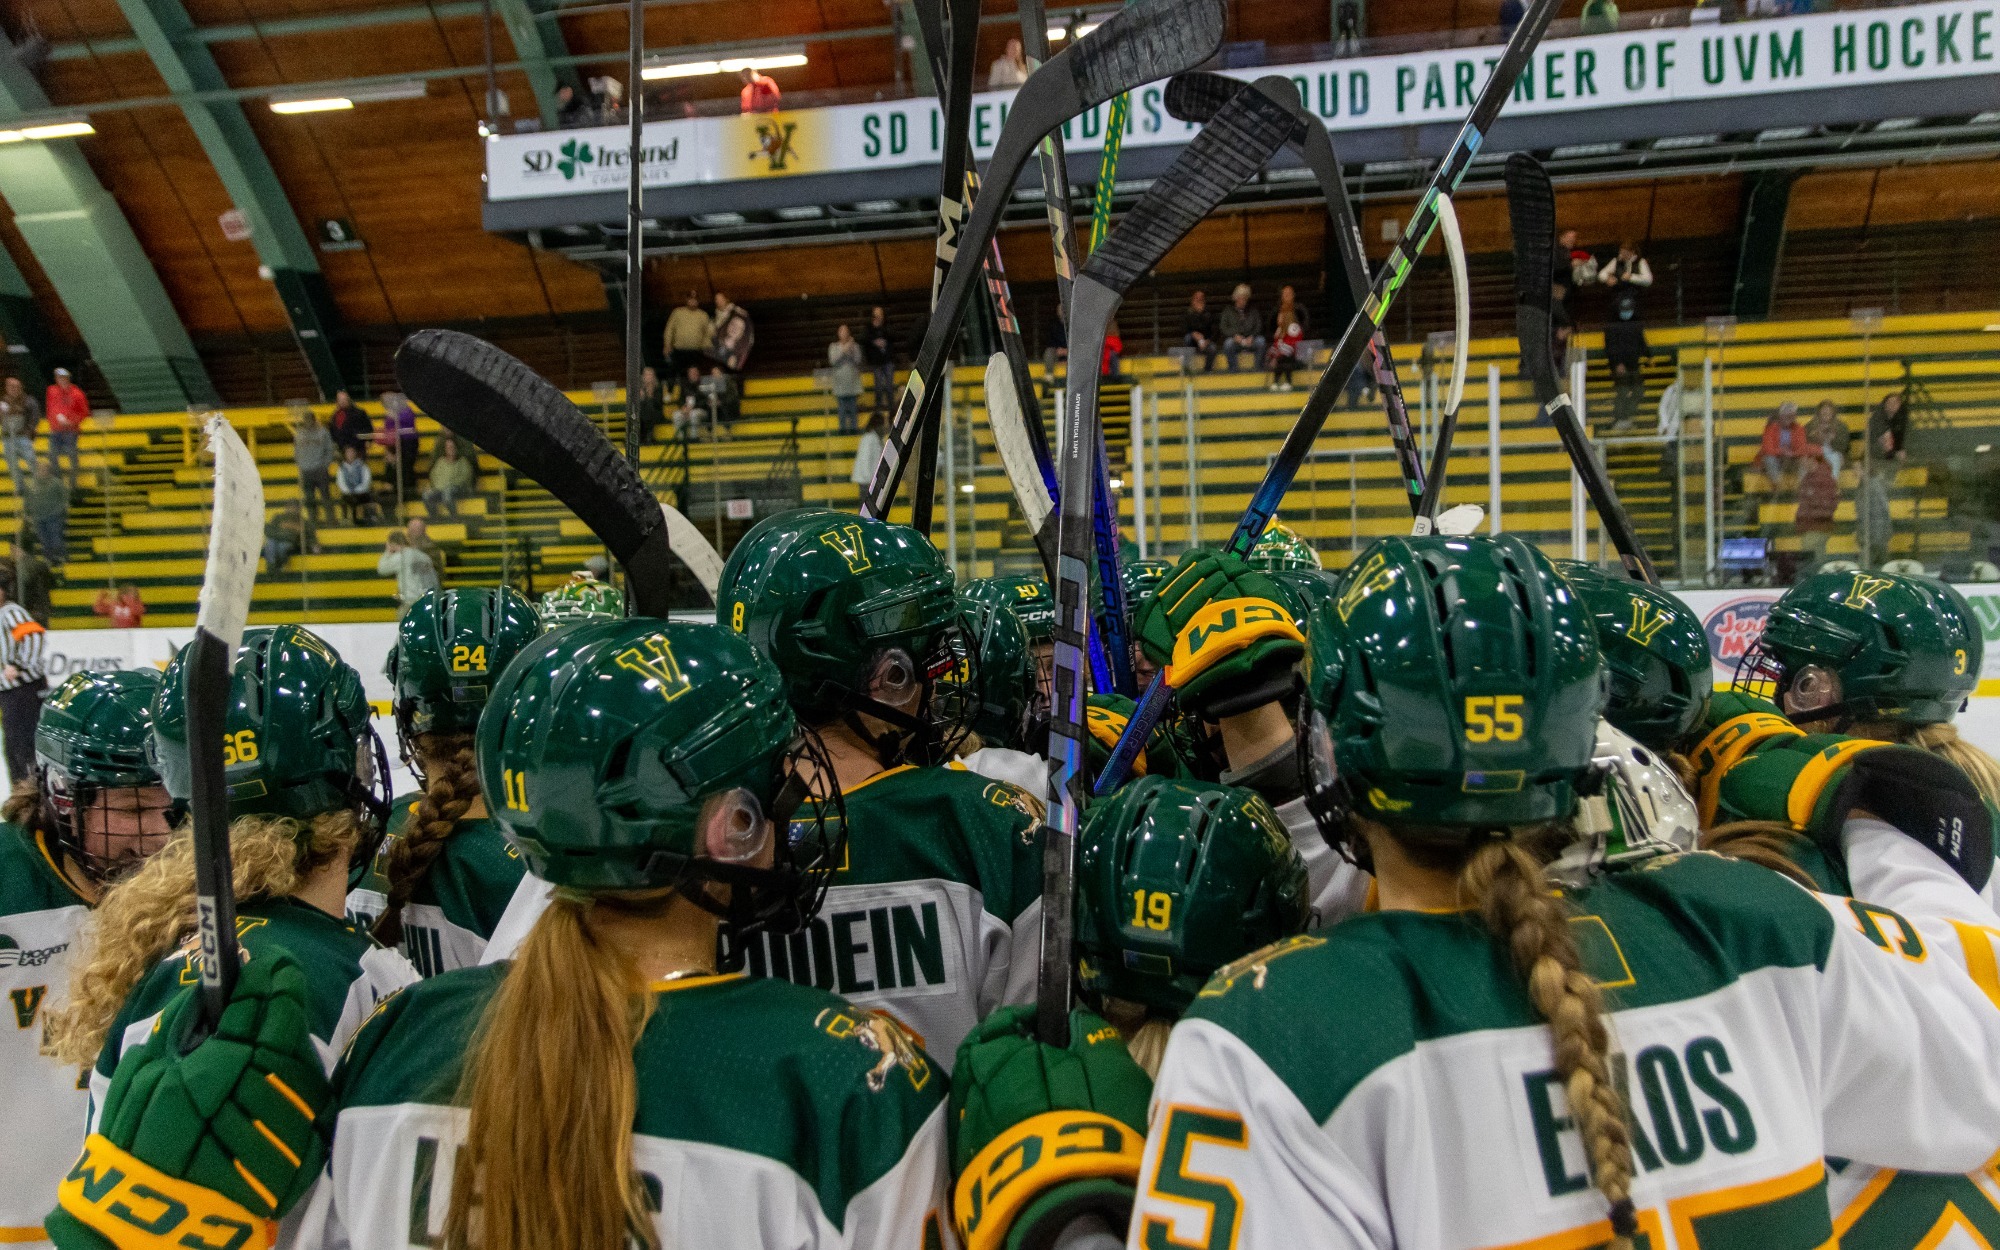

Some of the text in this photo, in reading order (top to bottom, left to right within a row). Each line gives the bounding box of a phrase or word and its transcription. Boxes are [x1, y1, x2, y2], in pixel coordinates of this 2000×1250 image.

[863, 113, 907, 158] SD
[1624, 40, 1676, 91] OF
[1702, 28, 1804, 85] UVM
[1834, 10, 1994, 74] HOCKE
[598, 136, 679, 168] Irend
[733, 602, 744, 633] 8
[1019, 609, 1056, 623] CCM
[453, 645, 487, 671] 24
[615, 633, 693, 703] V
[1953, 649, 1967, 676] 3
[1045, 554, 1088, 839] CCM
[1465, 695, 1524, 743] 55
[503, 768, 528, 812] 11
[1949, 816, 1963, 858] CCM
[1131, 889, 1173, 932] 19
[18, 956, 50, 967] EAST
[20, 942, 71, 959] HOCKEY
[200, 903, 217, 980] CCM
